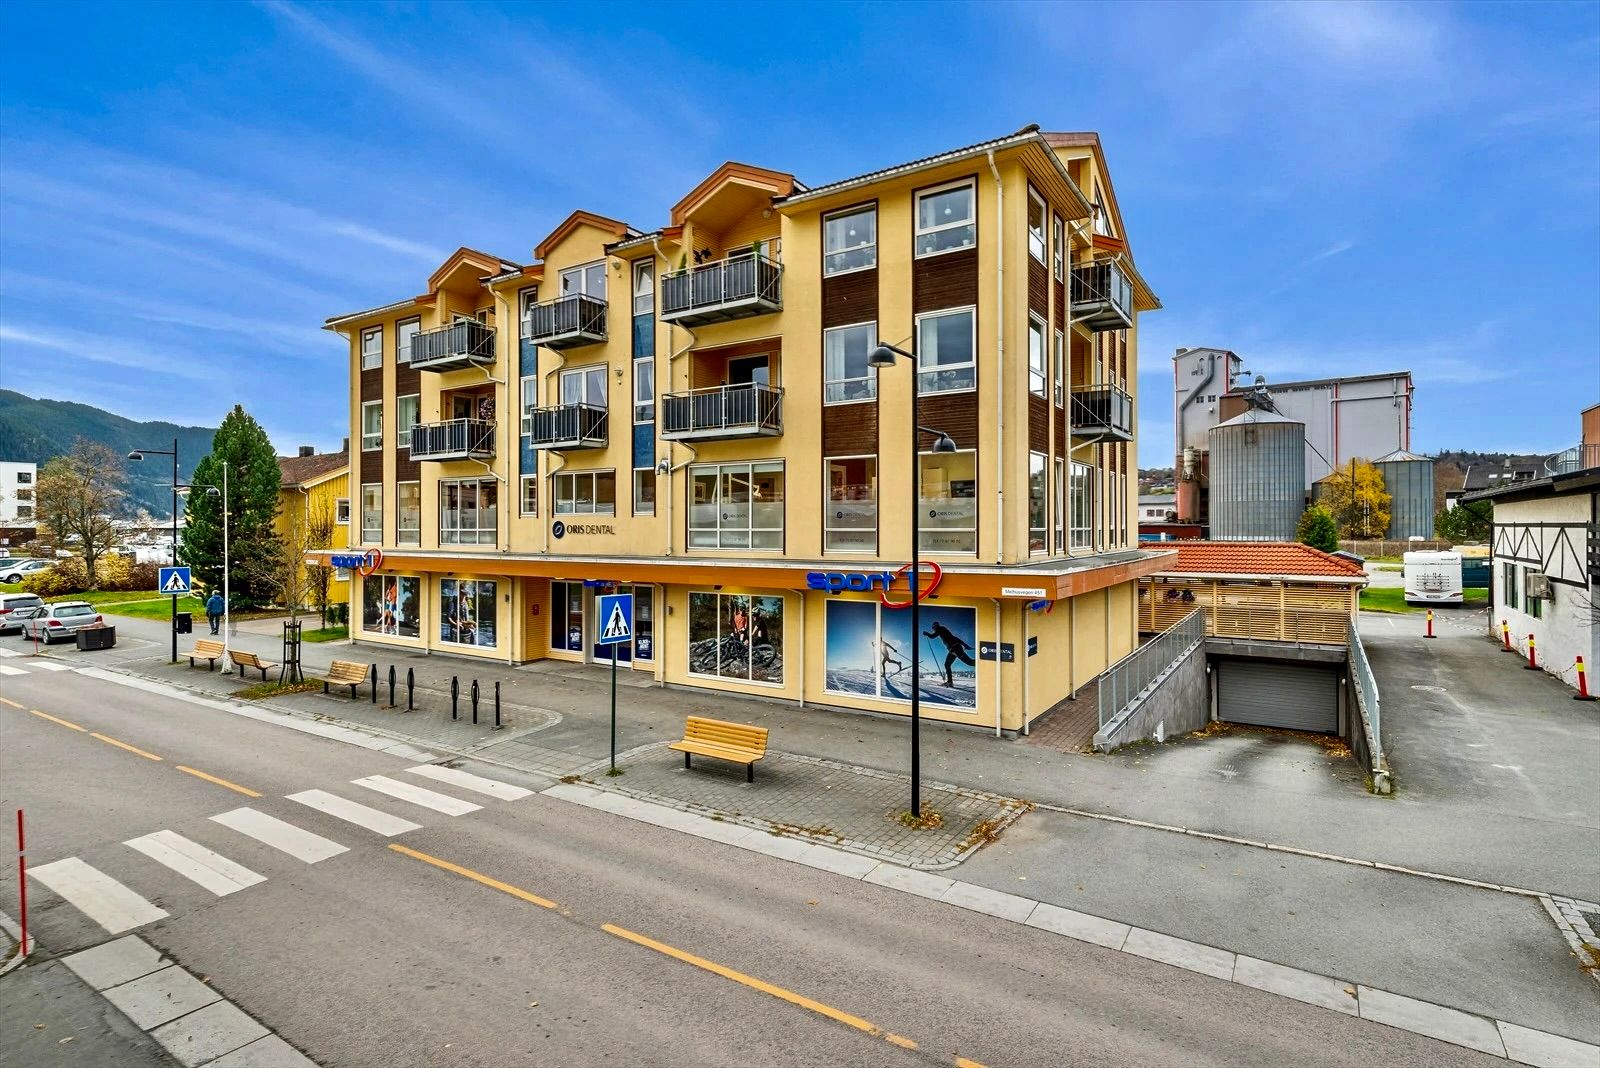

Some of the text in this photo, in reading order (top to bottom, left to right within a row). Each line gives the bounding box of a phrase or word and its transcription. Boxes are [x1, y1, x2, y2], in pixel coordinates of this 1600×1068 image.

[566, 524, 616, 536] ORIS DENTAL
[806, 570, 896, 594] sport
